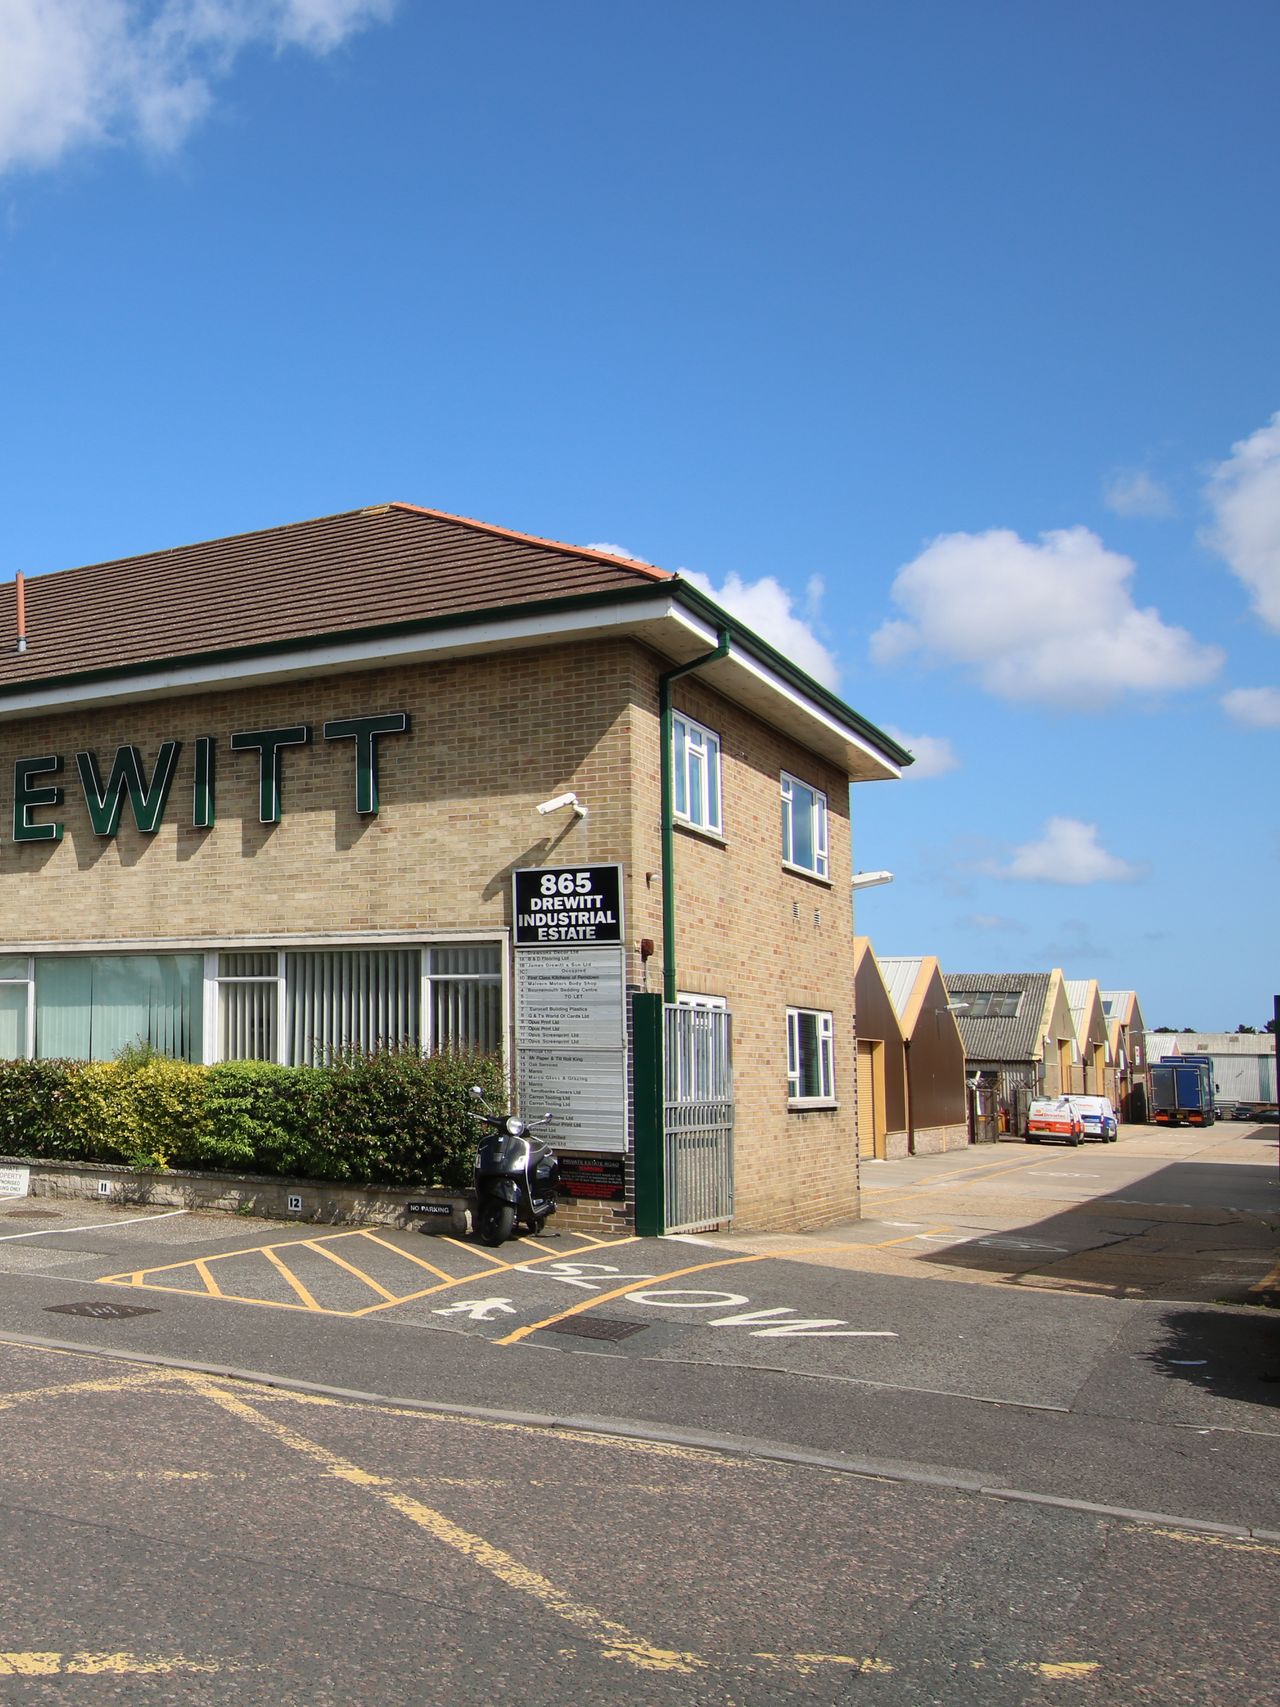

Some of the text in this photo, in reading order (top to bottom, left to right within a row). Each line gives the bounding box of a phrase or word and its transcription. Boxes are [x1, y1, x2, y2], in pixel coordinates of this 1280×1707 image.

[540, 872, 592, 895] 865
[530, 895, 603, 911] DREWITT
[518, 911, 616, 927] INDUSTRIAL
[538, 926, 596, 940] ESTATE
[100, 1182, 107, 1193] 11
[289, 1198, 301, 1209] 12
[420, 1205, 450, 1214] PARKING
[513, 1262, 899, 1338] SLOW
